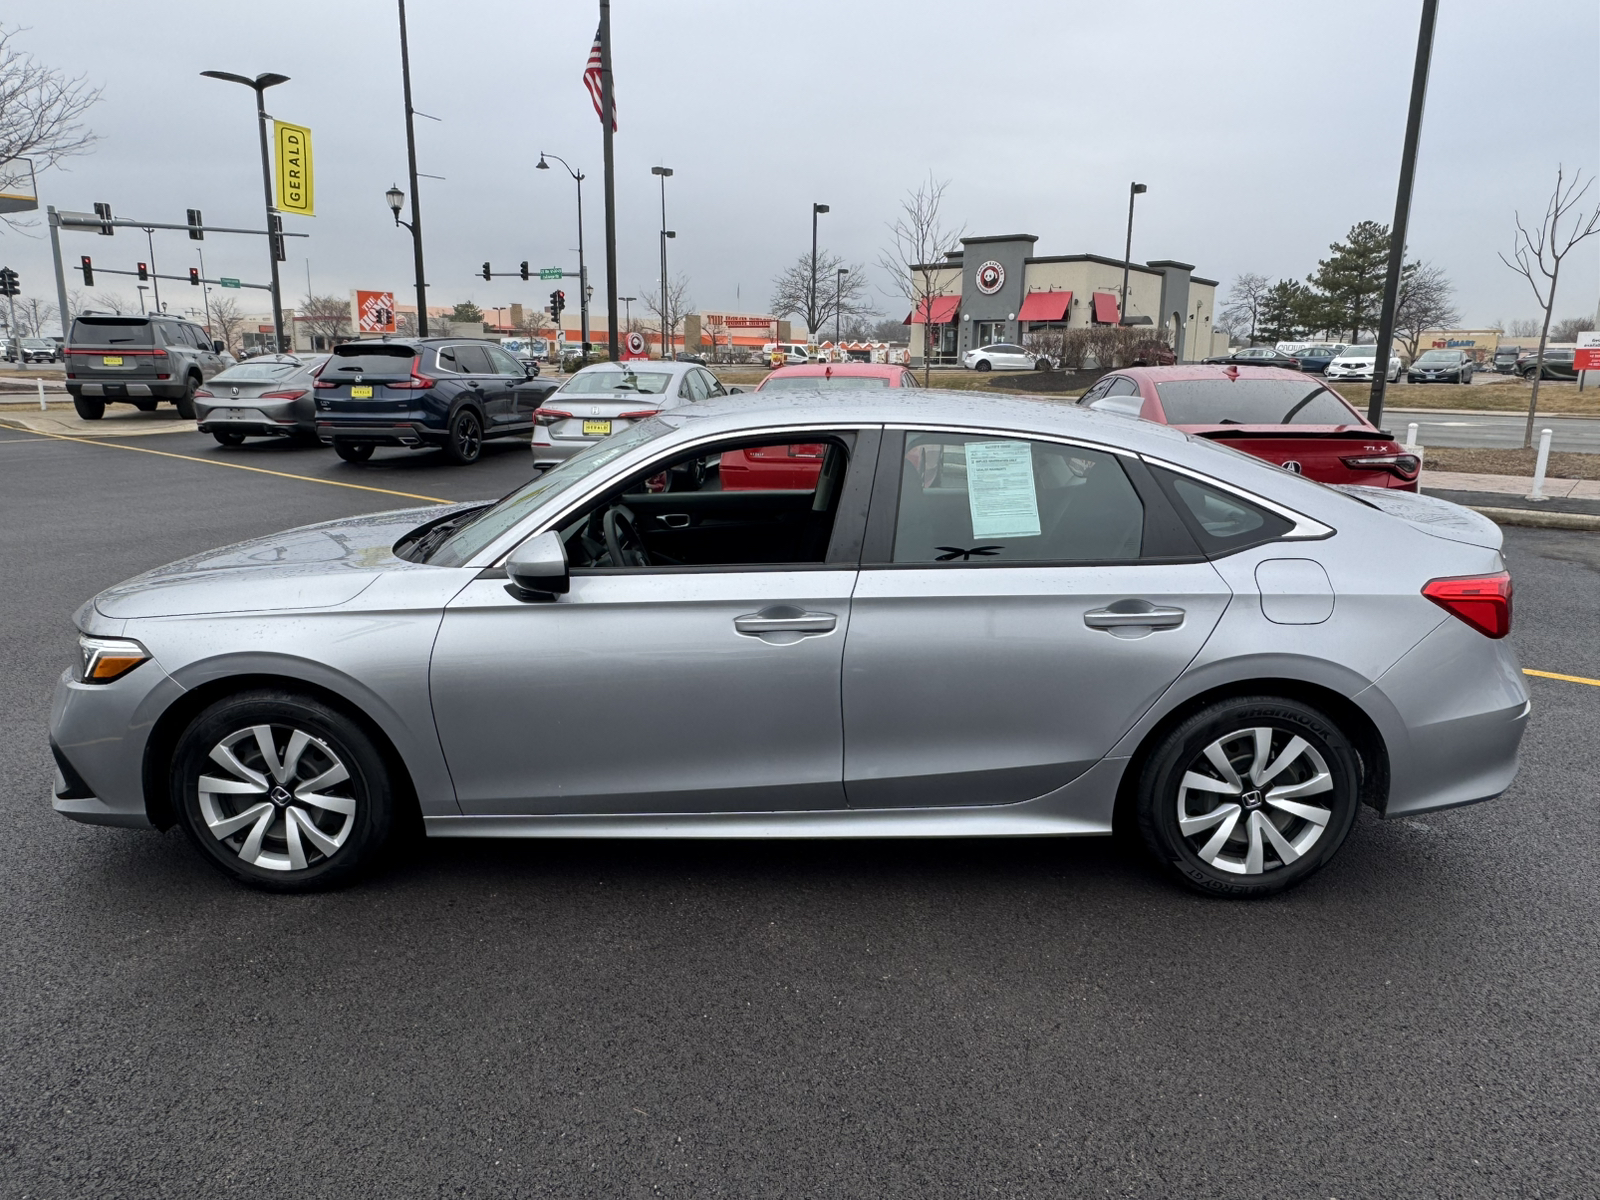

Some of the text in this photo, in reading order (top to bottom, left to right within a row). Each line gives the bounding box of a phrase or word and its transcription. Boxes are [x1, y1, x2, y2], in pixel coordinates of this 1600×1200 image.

[288, 135, 301, 202] GERALD
[359, 292, 393, 332] HOME
[362, 295, 377, 312] THE
[1186, 869, 1204, 880] GT
